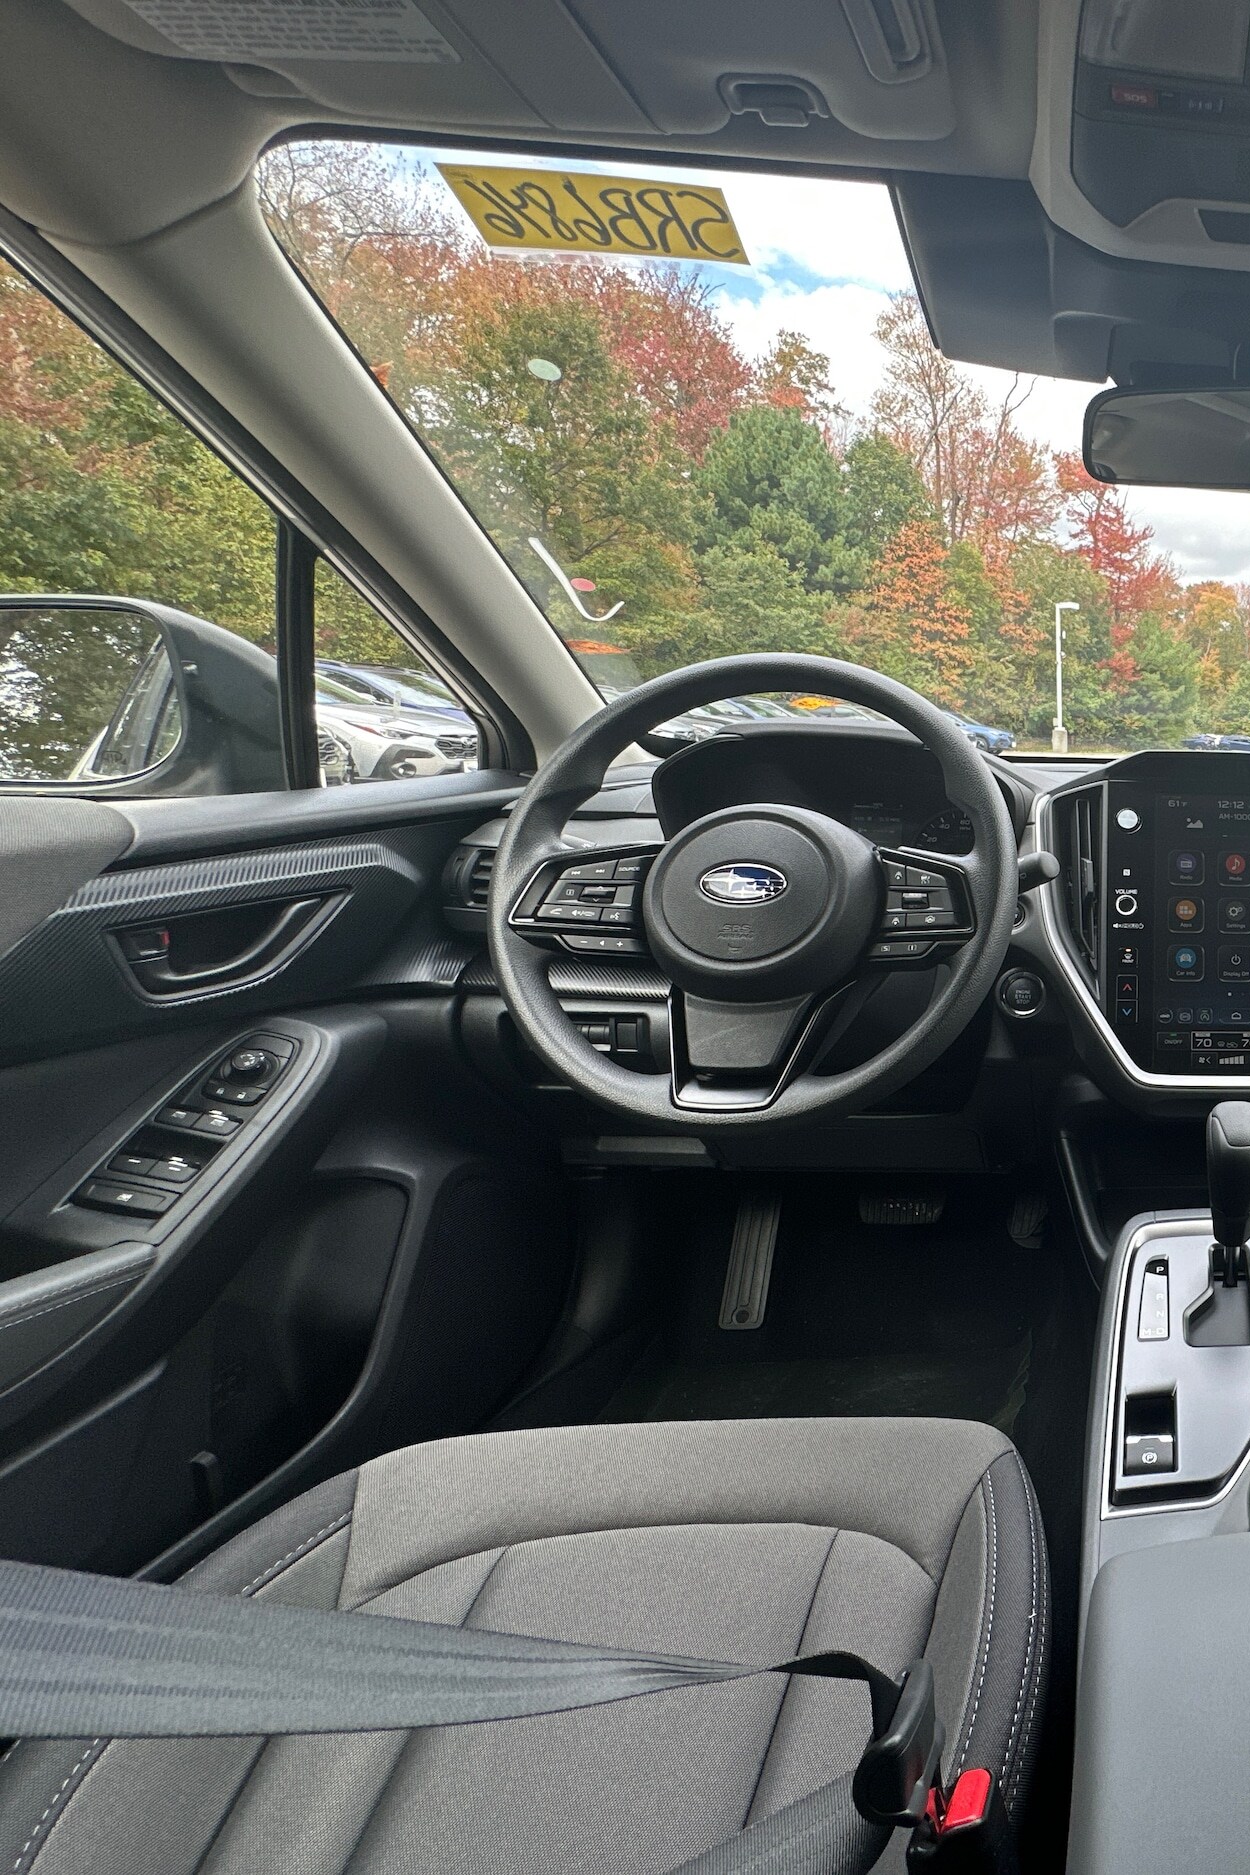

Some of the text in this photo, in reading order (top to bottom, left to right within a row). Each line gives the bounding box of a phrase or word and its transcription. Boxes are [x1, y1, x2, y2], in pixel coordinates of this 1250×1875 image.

[1123, 92, 1147, 102] SOS
[1218, 800, 1244, 809] 12:12
[1196, 1038, 1212, 1048] 70
